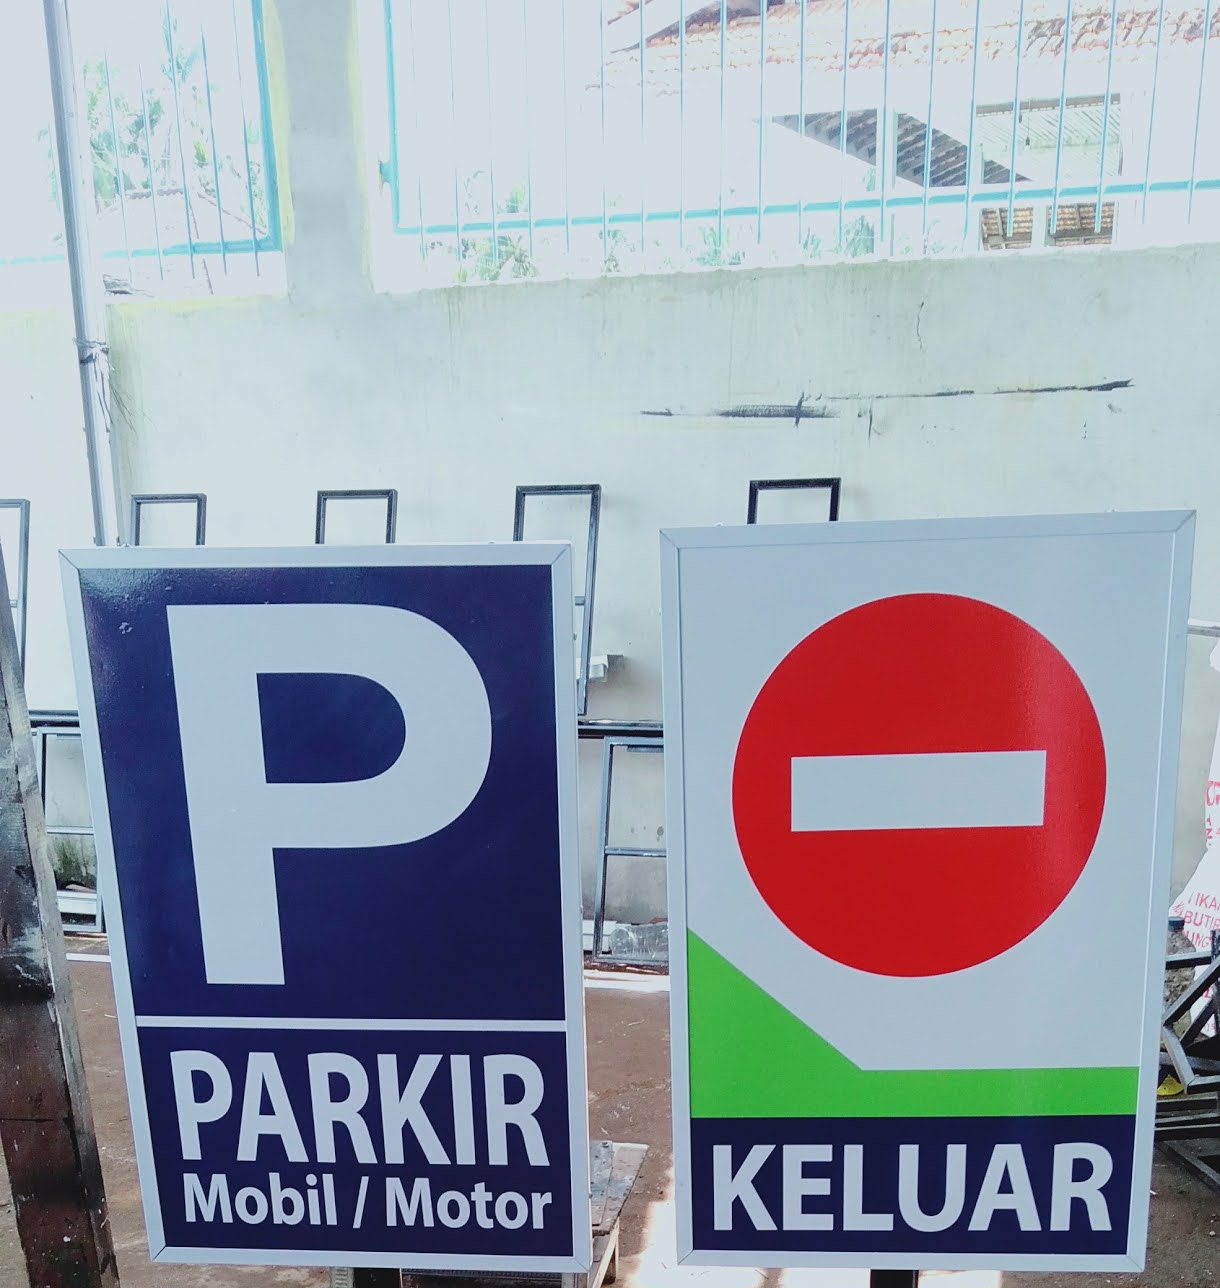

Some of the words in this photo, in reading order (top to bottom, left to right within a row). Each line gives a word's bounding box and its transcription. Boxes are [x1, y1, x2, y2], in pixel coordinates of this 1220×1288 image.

[167, 603, 492, 985] P
[170, 1049, 550, 1167] PARKIR
[184, 1172, 338, 1226] Mobil
[352, 1176, 370, 1229] /
[385, 1177, 553, 1230] Motor
[712, 1142, 1113, 1232] KELUAR
